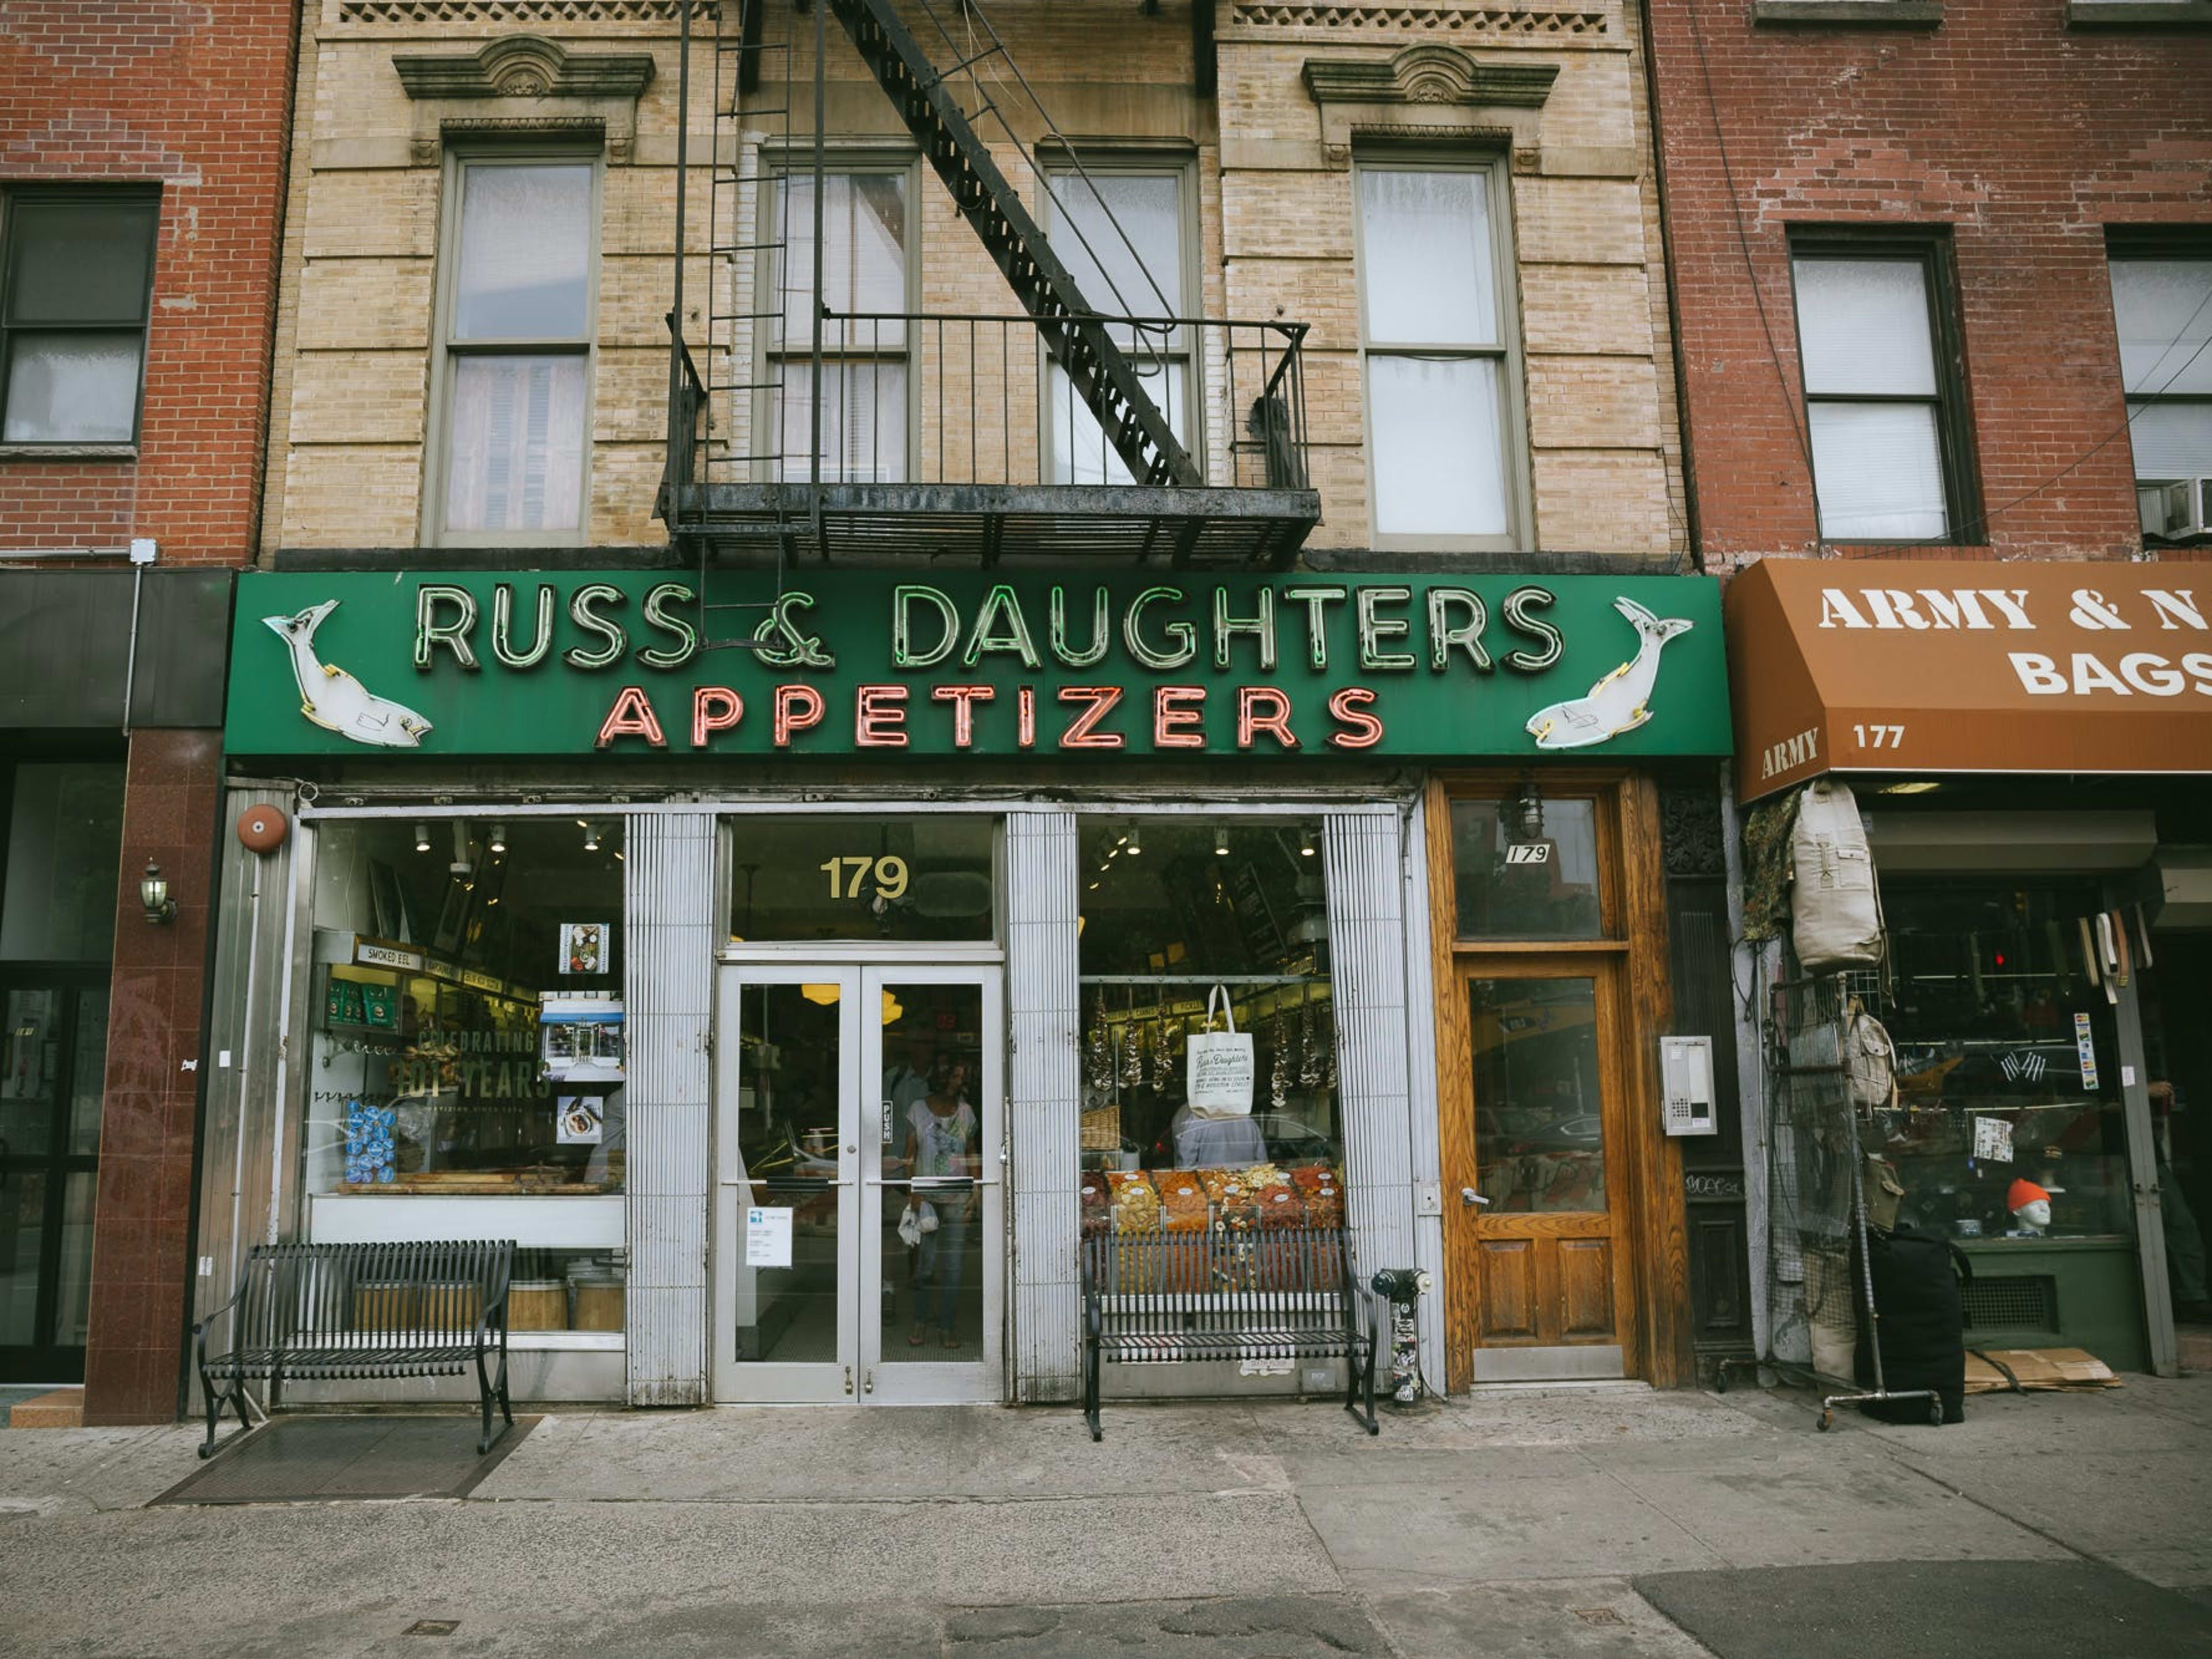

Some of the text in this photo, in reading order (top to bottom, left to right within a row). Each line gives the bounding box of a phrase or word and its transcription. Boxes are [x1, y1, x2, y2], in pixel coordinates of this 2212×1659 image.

[413, 583, 1565, 675] RUSS & DAUGHTERS
[1819, 588, 2036, 630] ARMY
[2069, 588, 2132, 630] &
[2007, 652, 2212, 696] BAGS
[594, 684, 1384, 749] APPETIZERS
[1853, 725, 1905, 748] 177
[1762, 727, 1819, 779] ARMY
[1511, 846, 1546, 862] 179
[820, 855, 908, 899] 179
[368, 948, 410, 965] SMOKED EEL
[418, 1031, 535, 1052] CELEBRATING
[461, 1059, 551, 1098] YEARS
